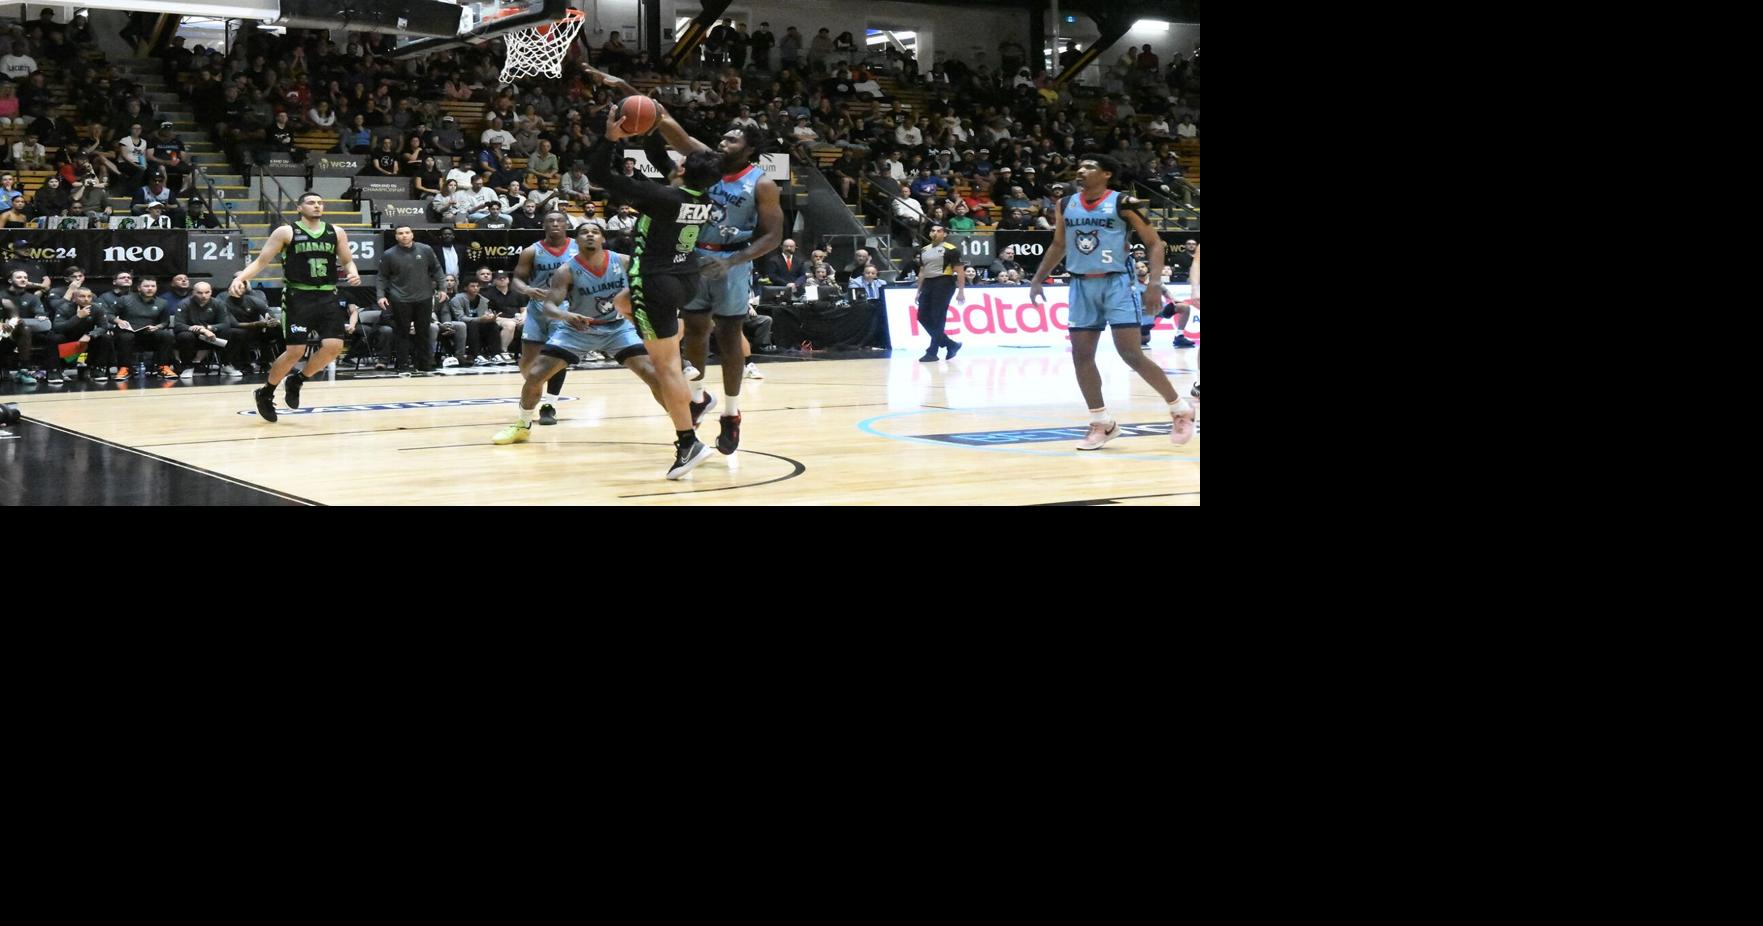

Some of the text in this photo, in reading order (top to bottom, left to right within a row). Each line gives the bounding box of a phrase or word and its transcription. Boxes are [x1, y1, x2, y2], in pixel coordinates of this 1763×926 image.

[330, 160, 357, 169] WC24
[396, 207, 425, 215] WC24
[1065, 217, 1114, 229] ALLIANCE
[676, 224, 700, 253] 9
[104, 246, 165, 262] neo
[188, 242, 234, 261] 124
[484, 246, 524, 256] WC24
[961, 240, 991, 256] 101
[1008, 243, 1044, 256] neo
[1101, 250, 1113, 264] 5
[308, 258, 329, 278] 15
[580, 278, 626, 297] ALLIANCE
